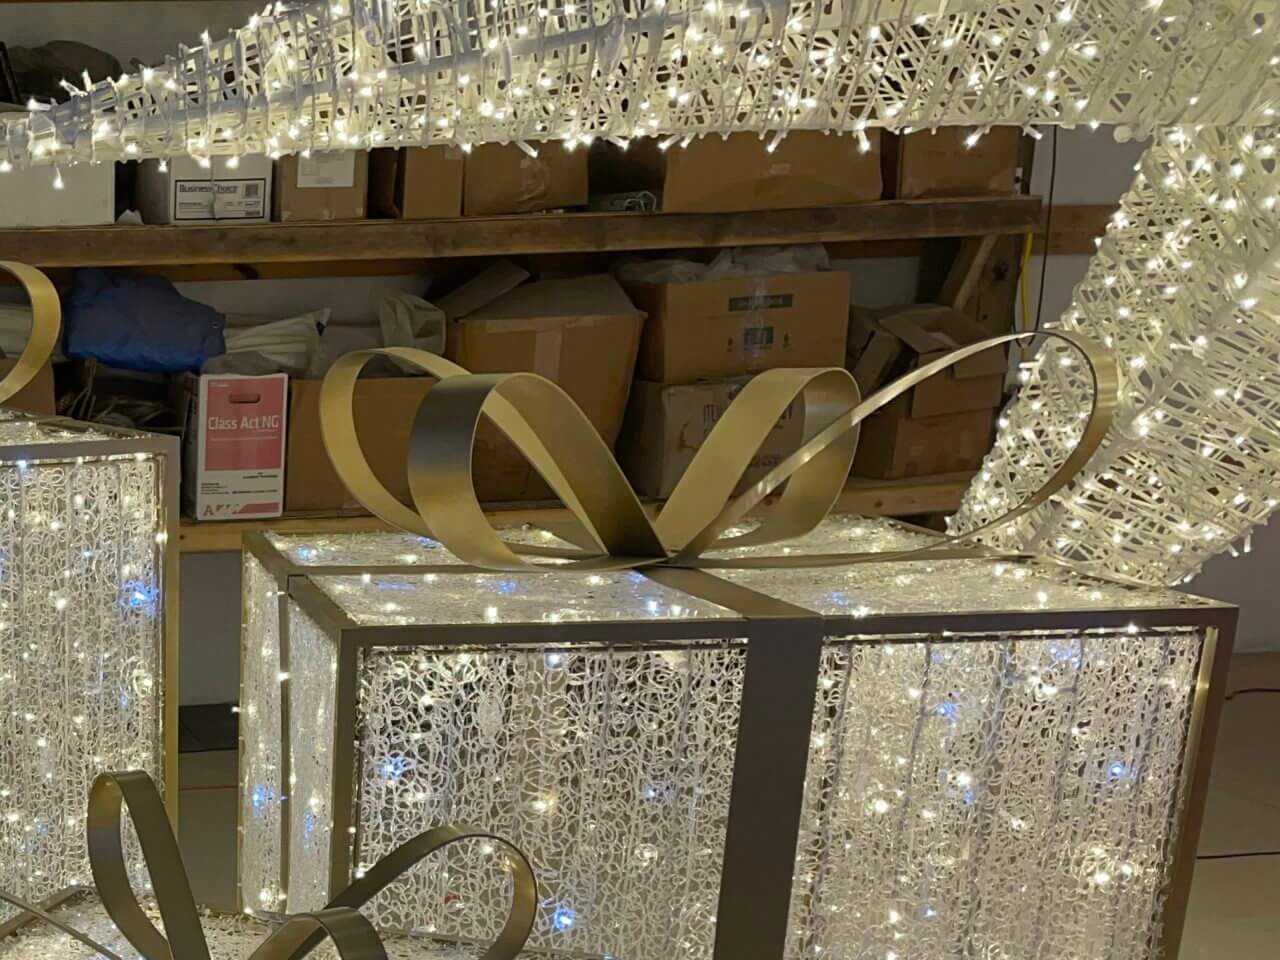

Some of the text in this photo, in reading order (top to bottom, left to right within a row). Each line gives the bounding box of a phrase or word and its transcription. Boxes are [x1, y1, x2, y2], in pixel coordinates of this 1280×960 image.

[208, 414, 280, 430] Class Act NG
